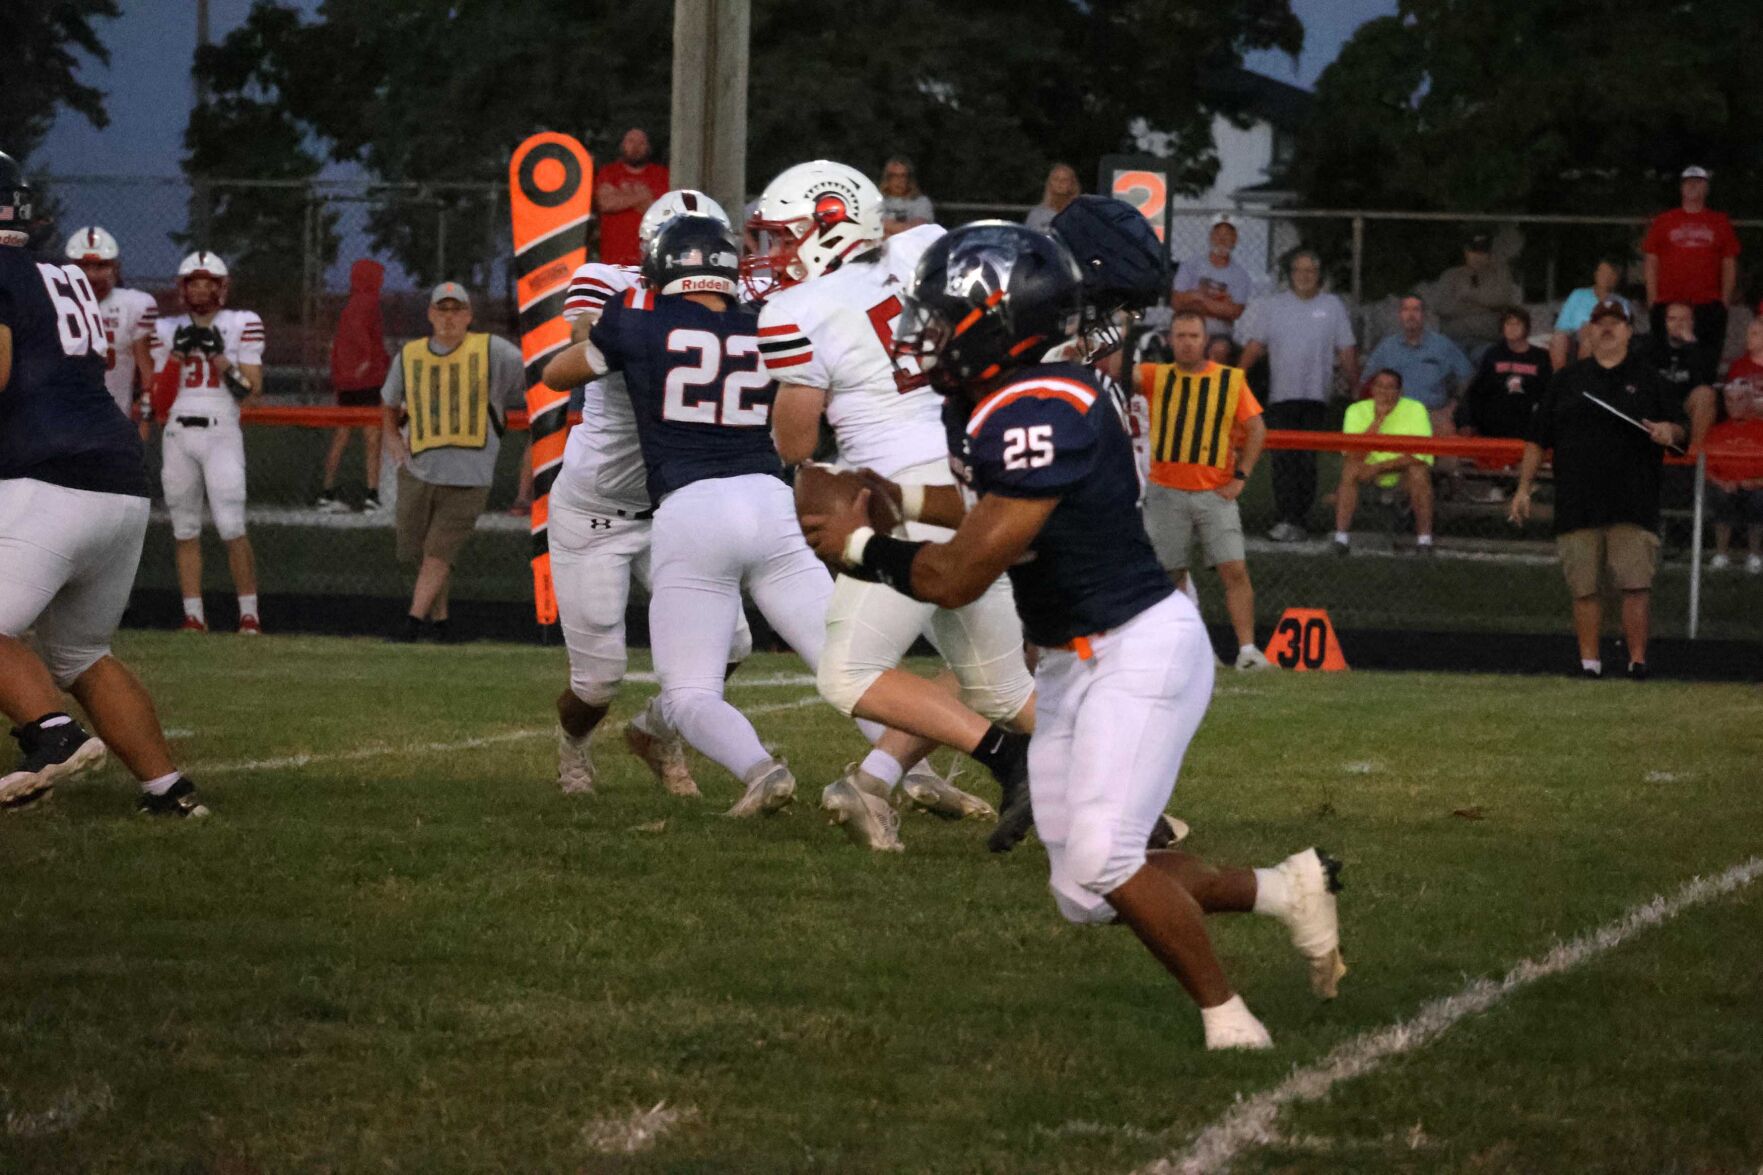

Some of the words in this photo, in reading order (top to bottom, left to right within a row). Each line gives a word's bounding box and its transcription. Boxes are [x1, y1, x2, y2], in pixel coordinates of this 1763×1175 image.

[36, 262, 108, 357] 68
[682, 279, 730, 291] Riddell
[184, 356, 221, 389] 31
[661, 328, 771, 427] 22
[1002, 424, 1055, 471] 25
[1277, 617, 1327, 669] 30
